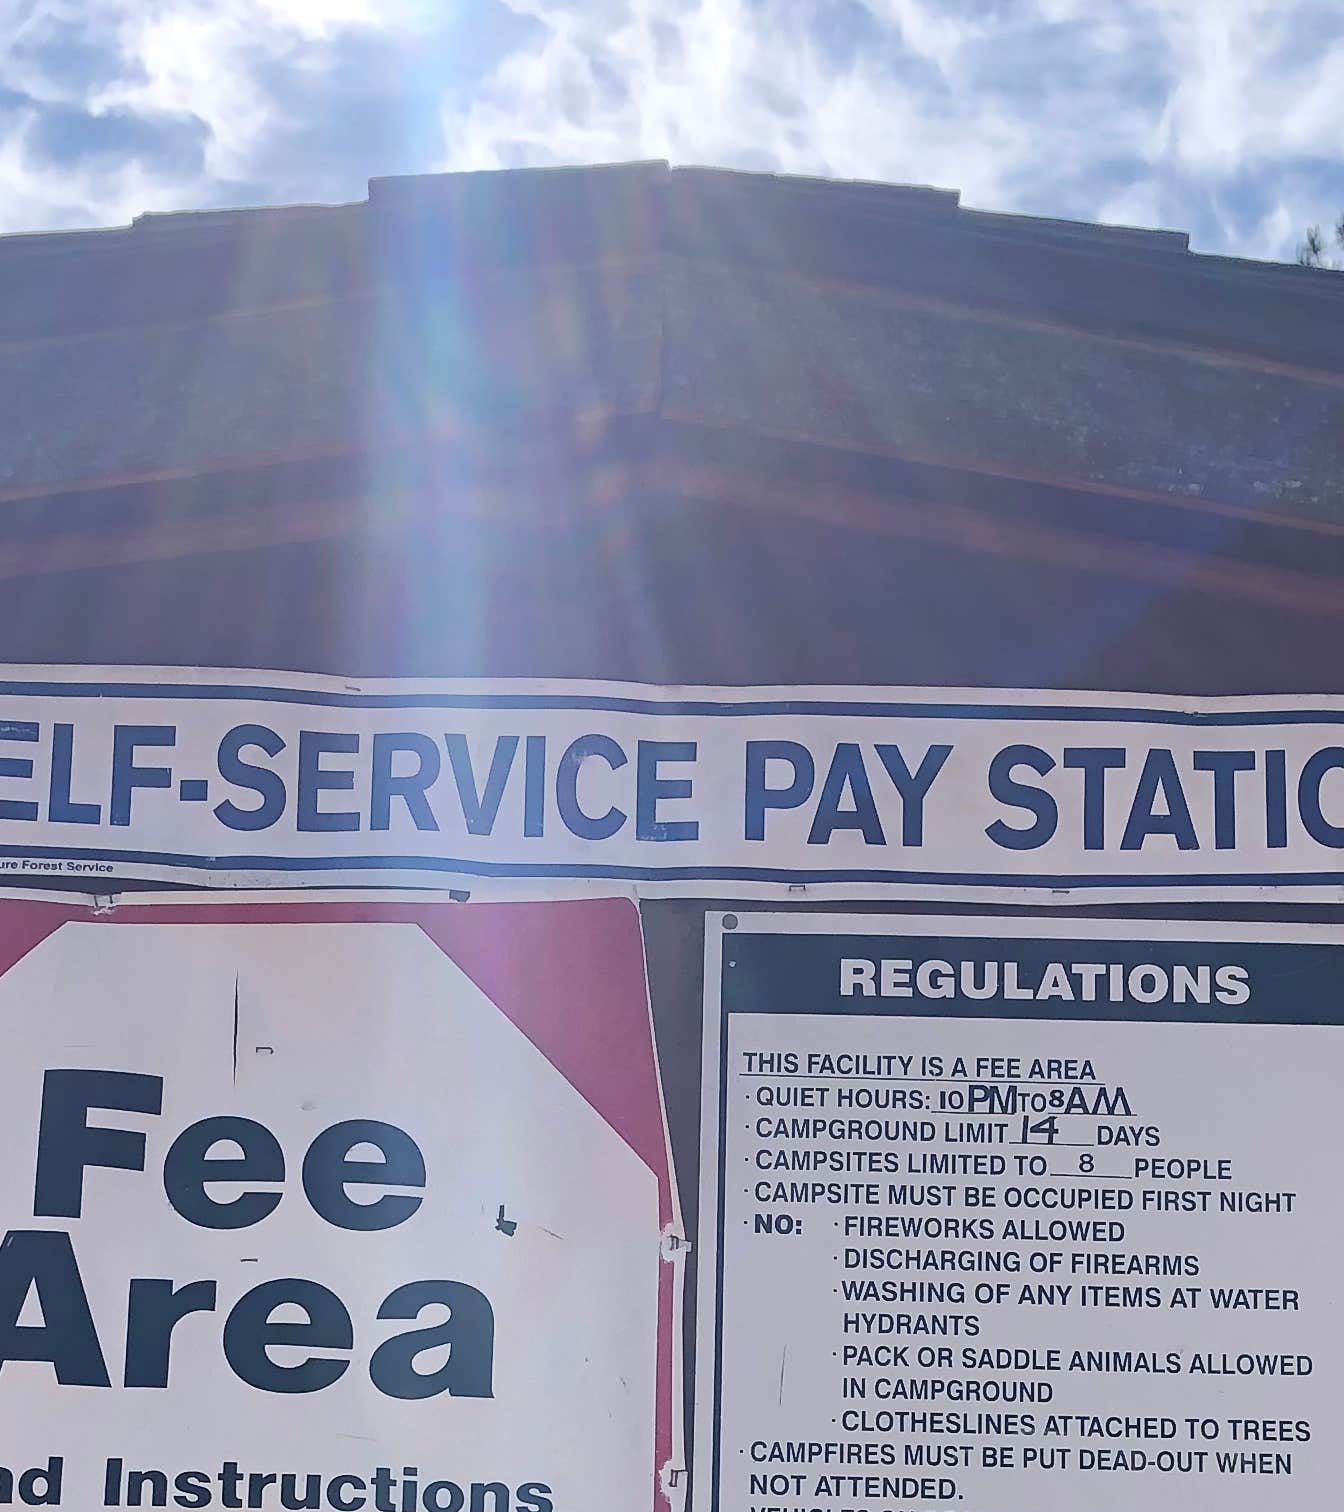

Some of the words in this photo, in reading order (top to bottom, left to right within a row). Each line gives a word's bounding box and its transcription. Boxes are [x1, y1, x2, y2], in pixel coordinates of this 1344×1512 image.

[744, 740, 954, 847] PAY
[21, 860, 62, 870] Forest
[66, 861, 113, 872] Service
[840, 958, 1250, 1004] REGULATIONS
[32, 1068, 427, 1231] Fee
[756, 1117, 935, 1142] CAMPGROUND
[943, 1121, 1007, 1144] LIMIT
[1020, 1115, 1059, 1144] 14
[1097, 1125, 1161, 1147] DAYS
